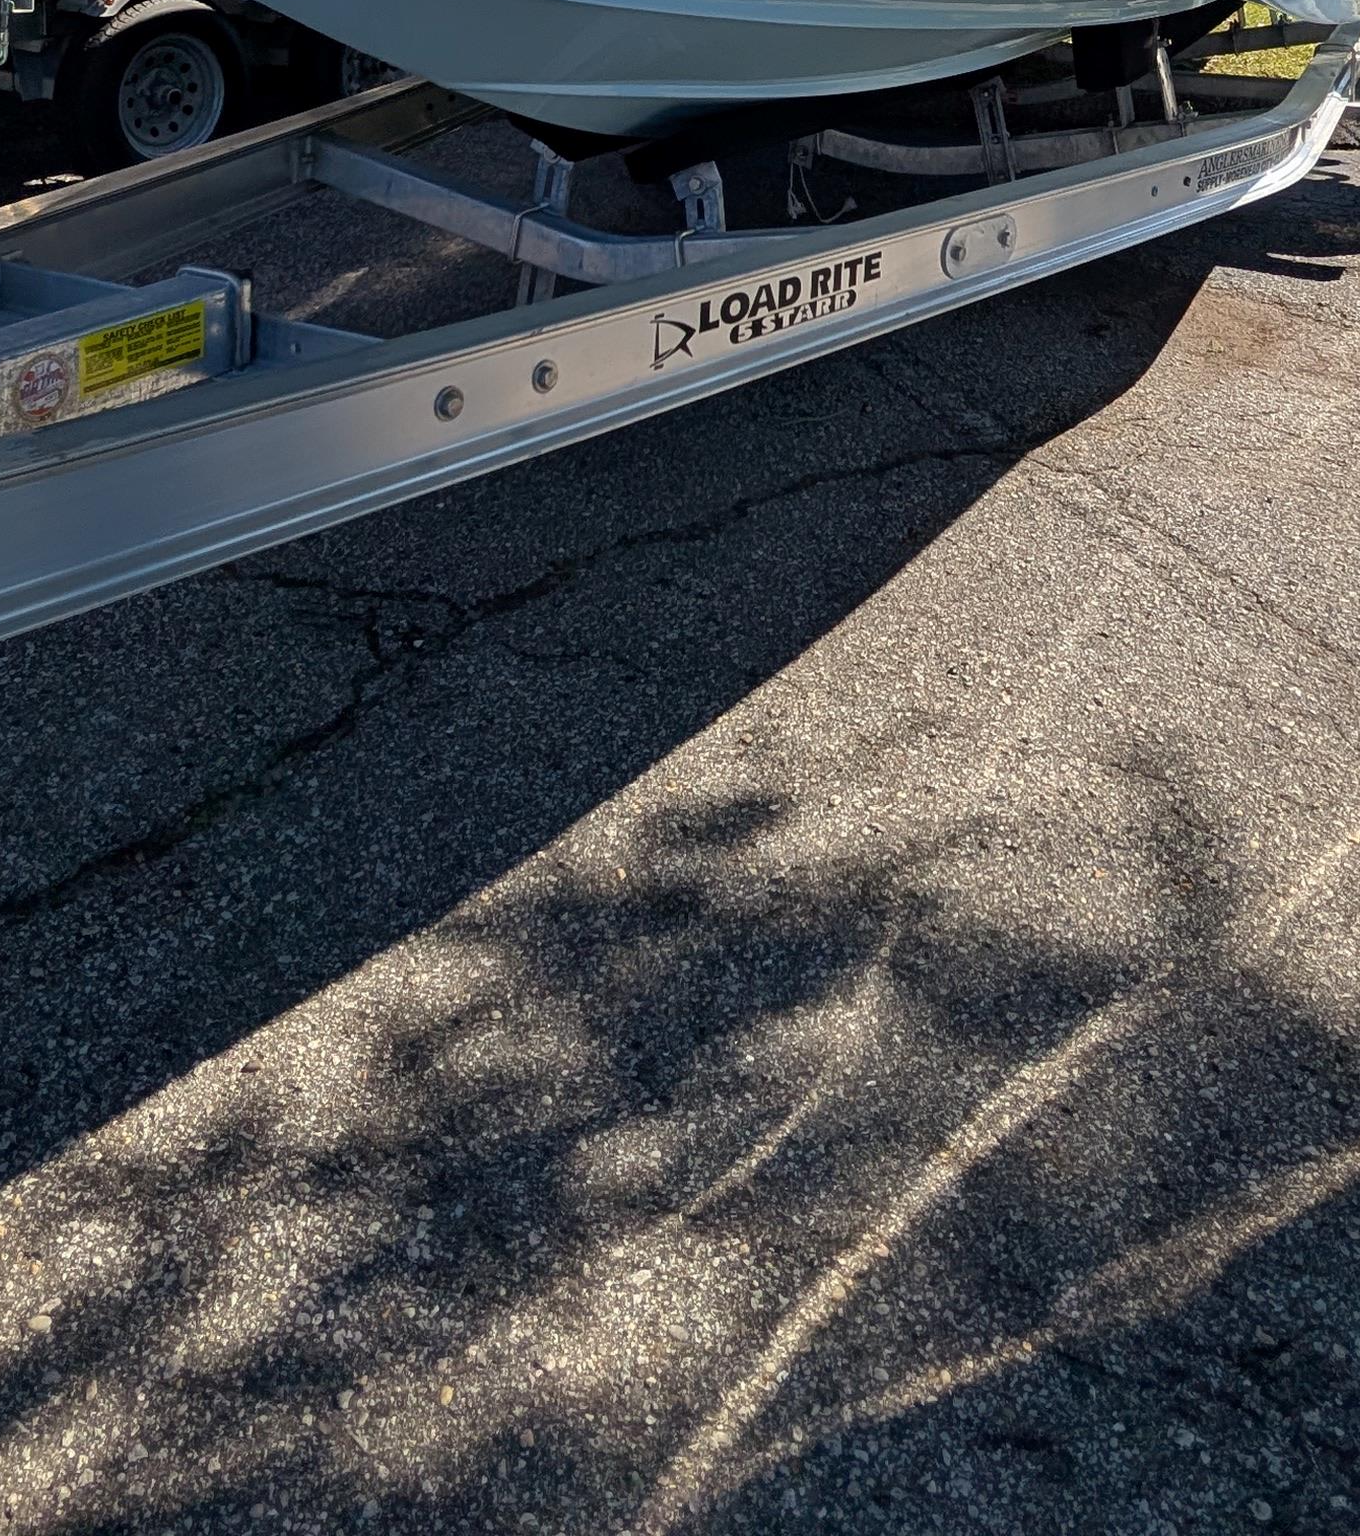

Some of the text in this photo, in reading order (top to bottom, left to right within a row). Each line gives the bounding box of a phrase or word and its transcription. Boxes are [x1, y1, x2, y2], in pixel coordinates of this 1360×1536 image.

[698, 251, 883, 334] LOAD RITE
[759, 291, 851, 334] STARR
